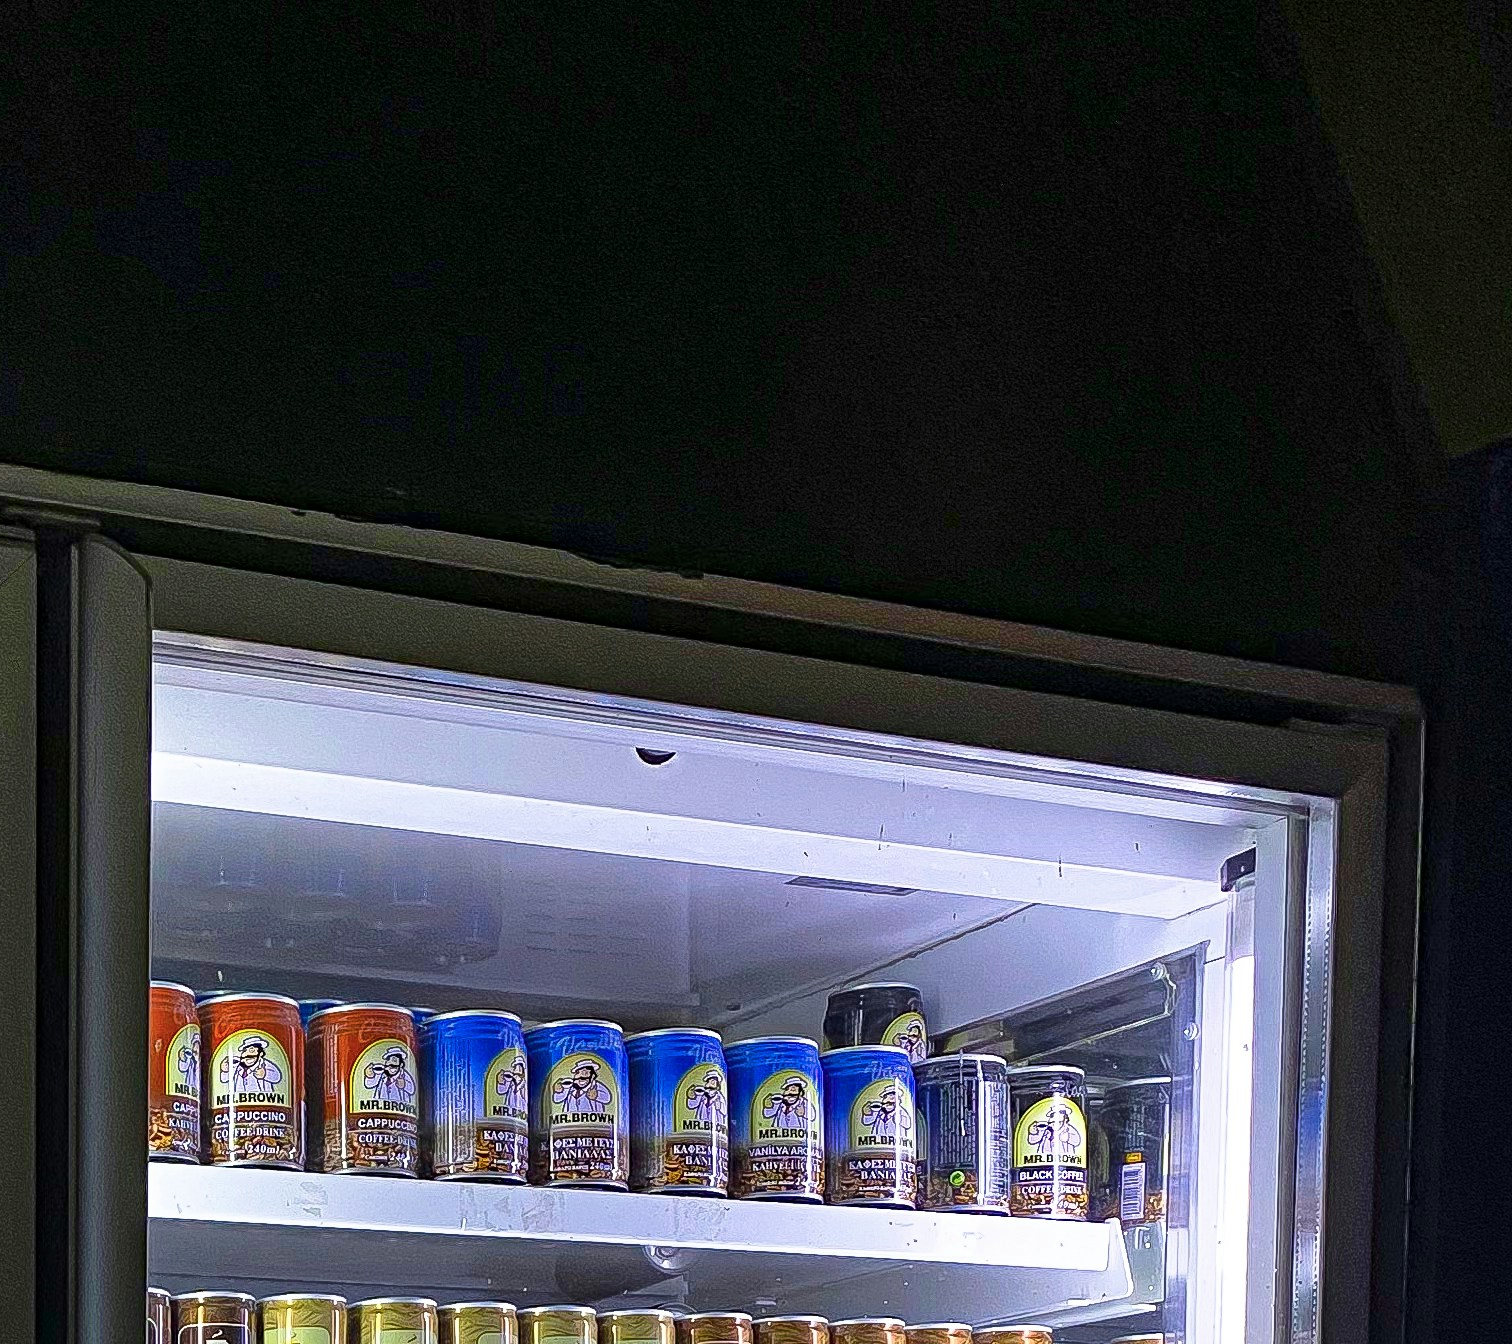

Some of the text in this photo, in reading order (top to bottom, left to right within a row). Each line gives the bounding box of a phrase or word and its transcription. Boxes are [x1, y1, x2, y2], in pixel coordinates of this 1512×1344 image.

[217, 1093, 284, 1105] MR.BROWN
[215, 1113, 285, 1122] CAPPUCCINO
[256, 1127, 284, 1137] DRINK
[1019, 1169, 1054, 1181] BLACK
